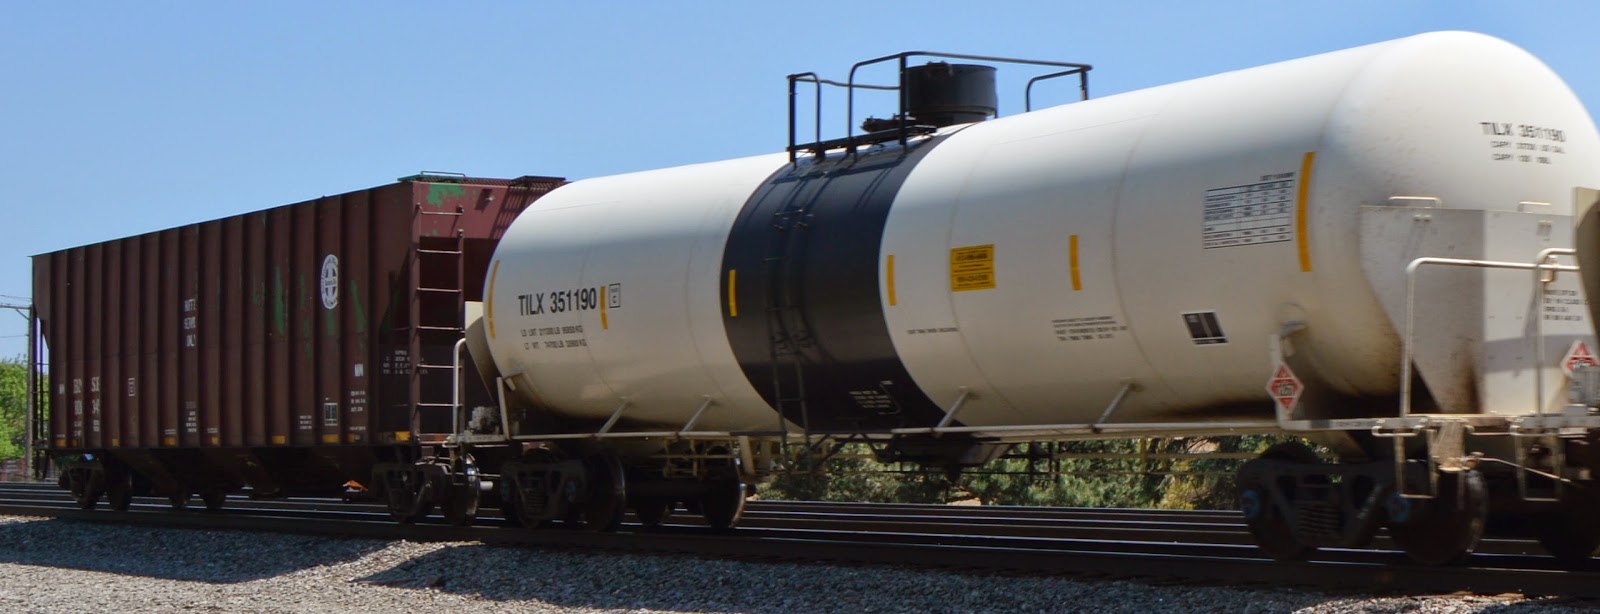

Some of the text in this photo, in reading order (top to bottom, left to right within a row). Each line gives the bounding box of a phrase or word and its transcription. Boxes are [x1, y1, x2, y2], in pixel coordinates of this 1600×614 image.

[1479, 122, 1566, 142] TILX 351190
[518, 287, 597, 316] TILX 351190
